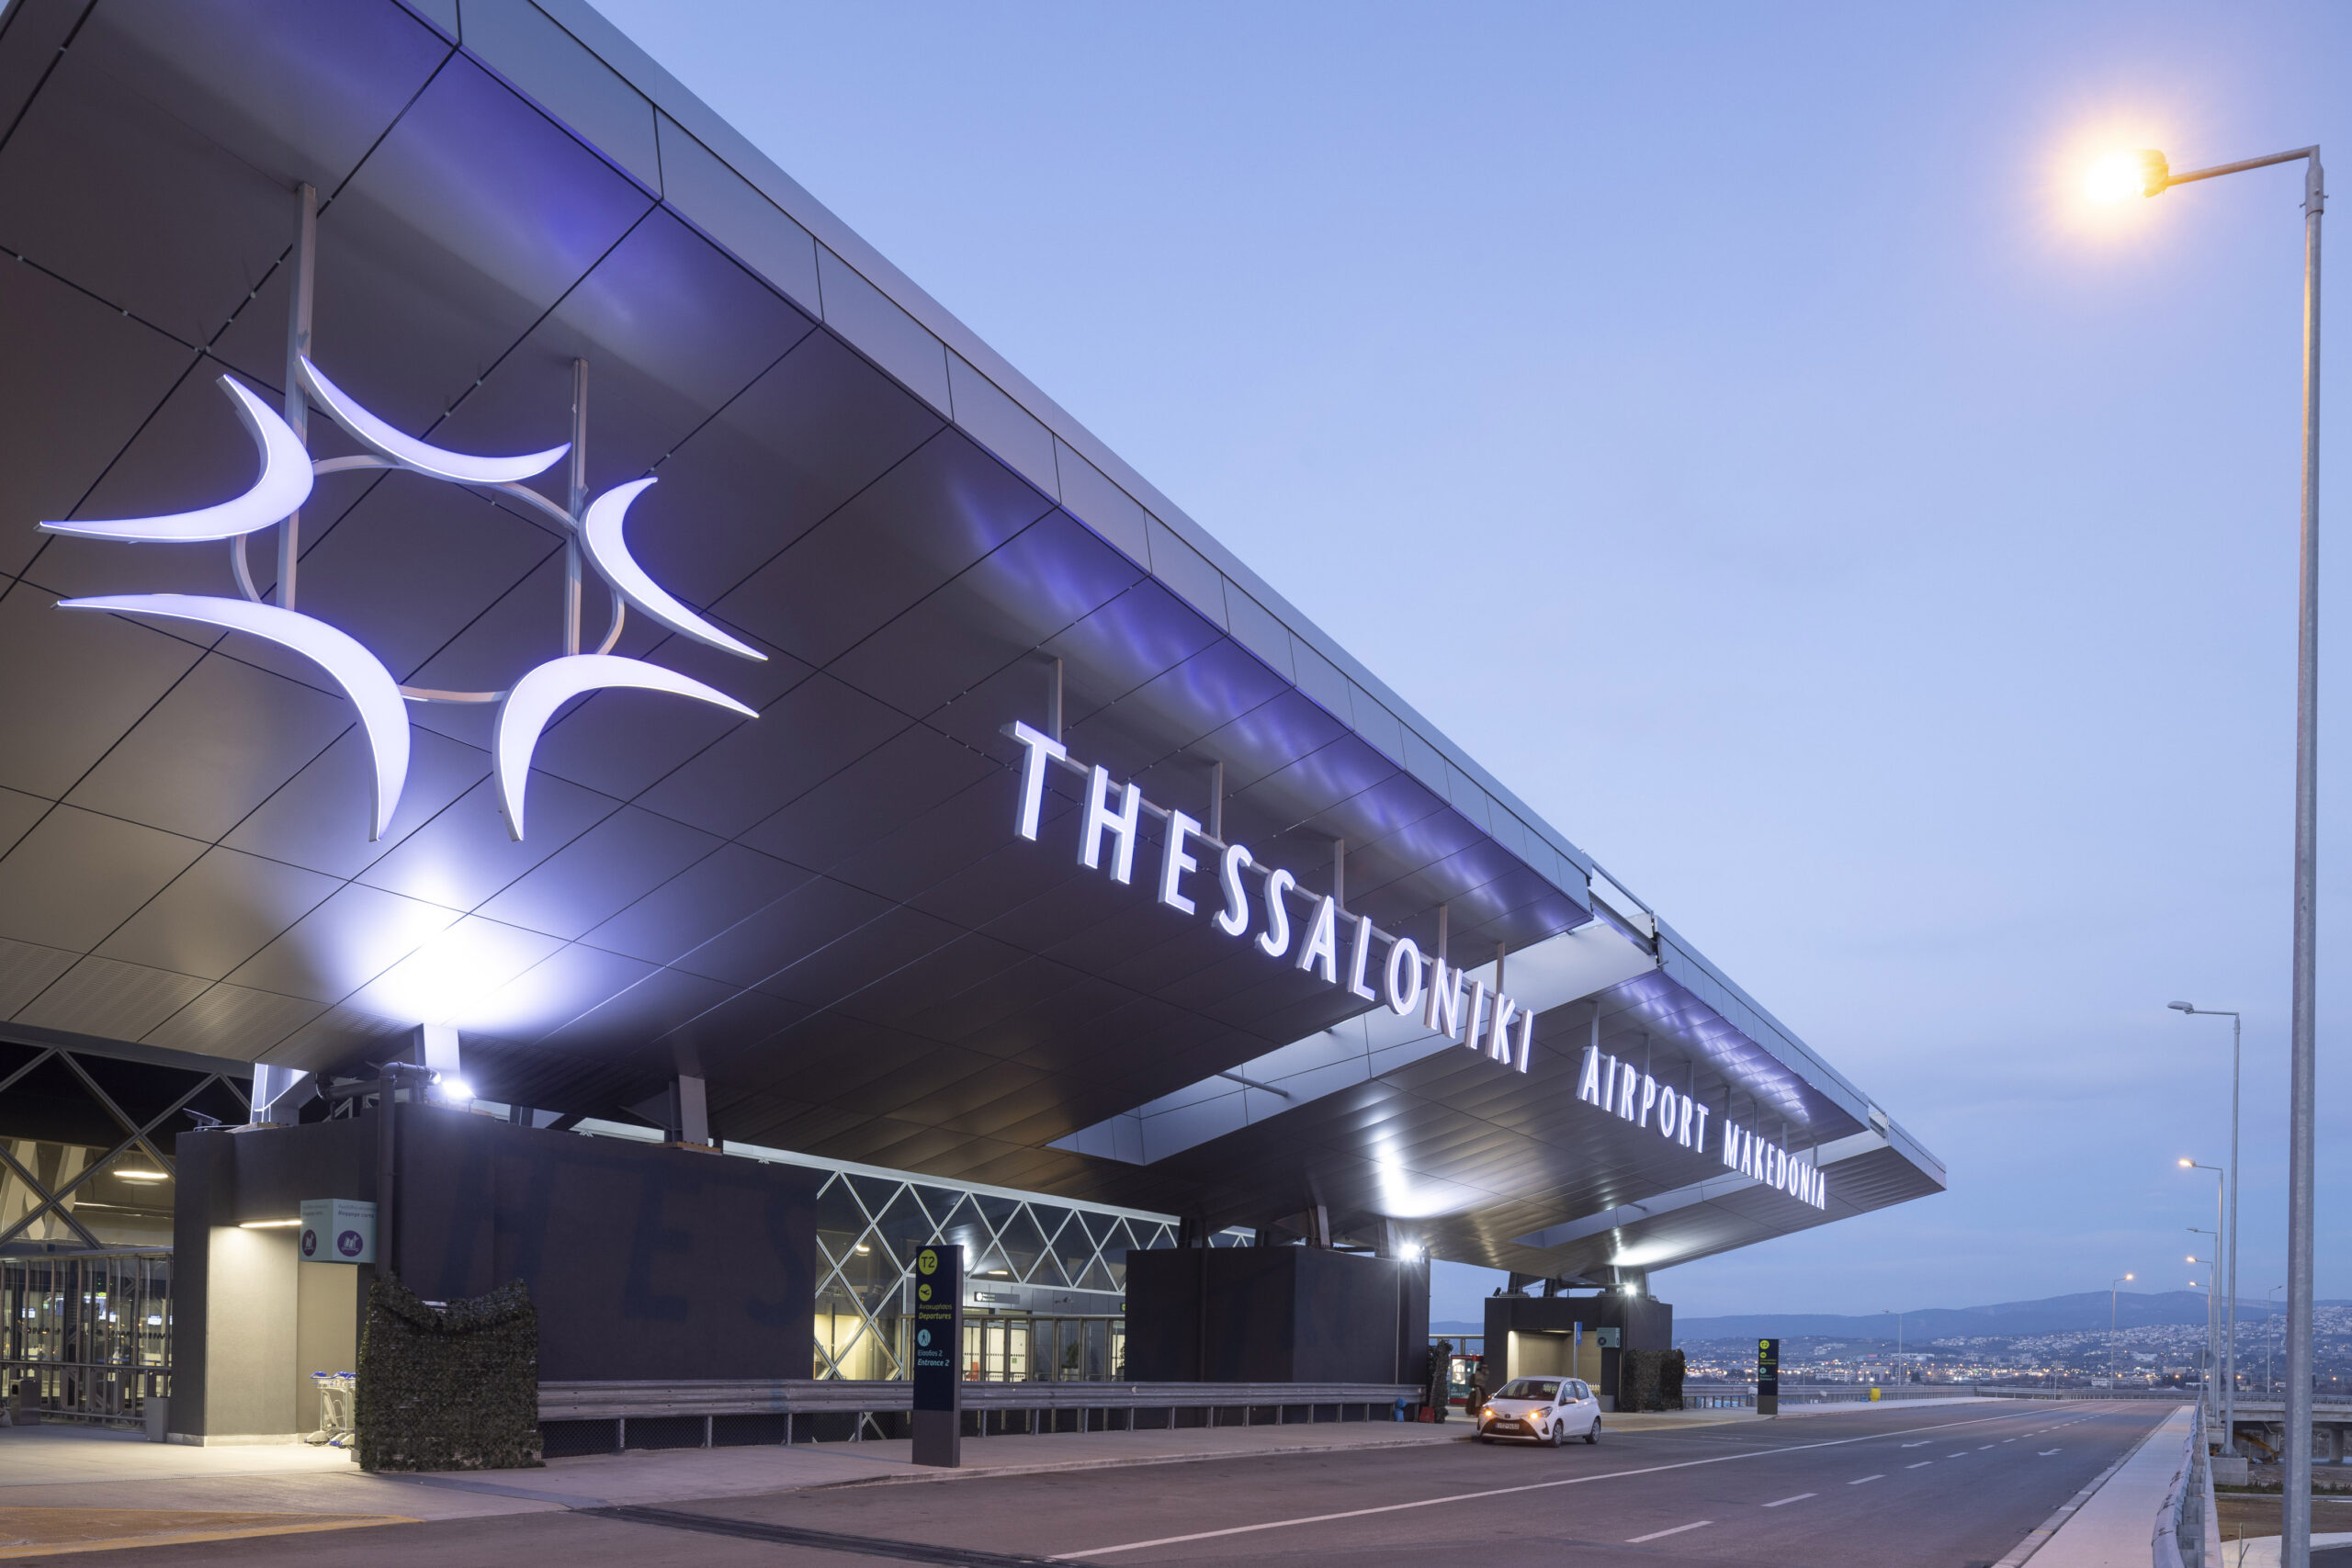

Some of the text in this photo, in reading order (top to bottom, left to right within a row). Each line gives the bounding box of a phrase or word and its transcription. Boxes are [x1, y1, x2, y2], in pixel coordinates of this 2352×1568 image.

[1013, 719, 1826, 1211] THESSALONIKI AIRPORT MAKEDONIA
[921, 1256, 935, 1269] T2
[919, 1312, 952, 1321] Departures
[944, 1359, 950, 1367] 2
